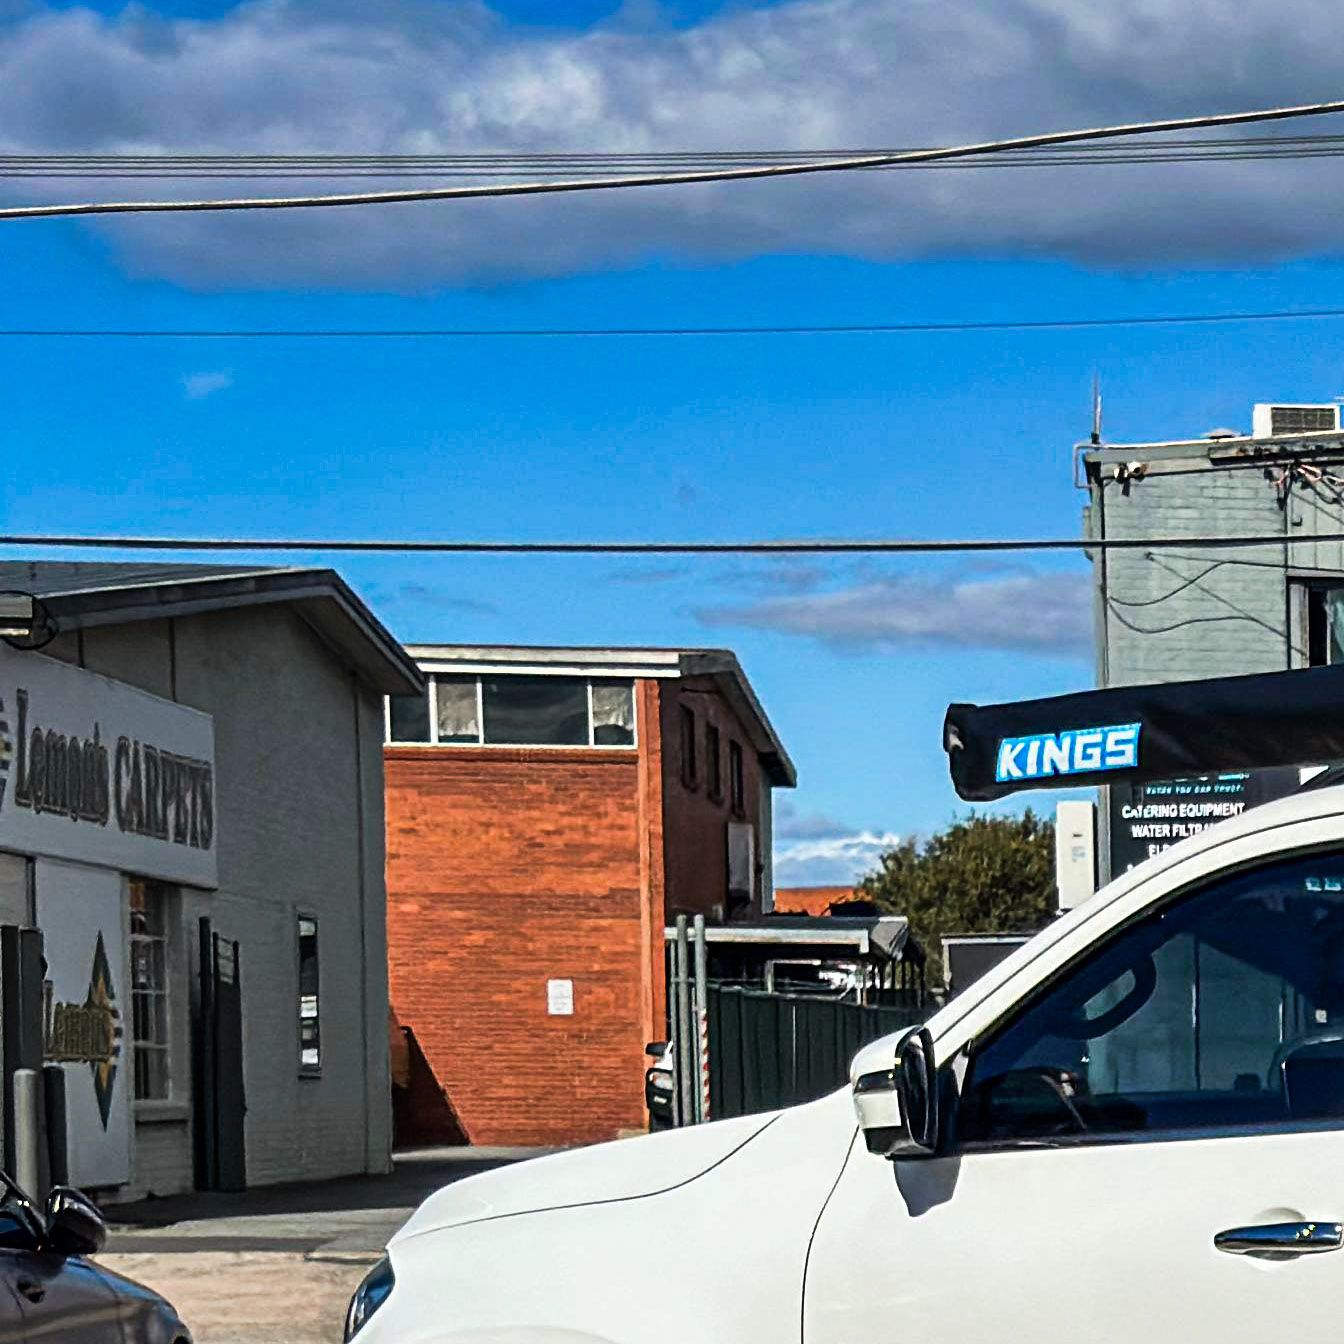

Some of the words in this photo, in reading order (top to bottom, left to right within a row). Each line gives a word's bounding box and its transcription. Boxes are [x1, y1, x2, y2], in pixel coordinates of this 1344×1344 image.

[1001, 729, 1136, 778] KINGS
[1121, 803, 1178, 819] CATERING
[1179, 802, 1246, 818] EQUIPMENT
[1131, 824, 1171, 838] WATER
